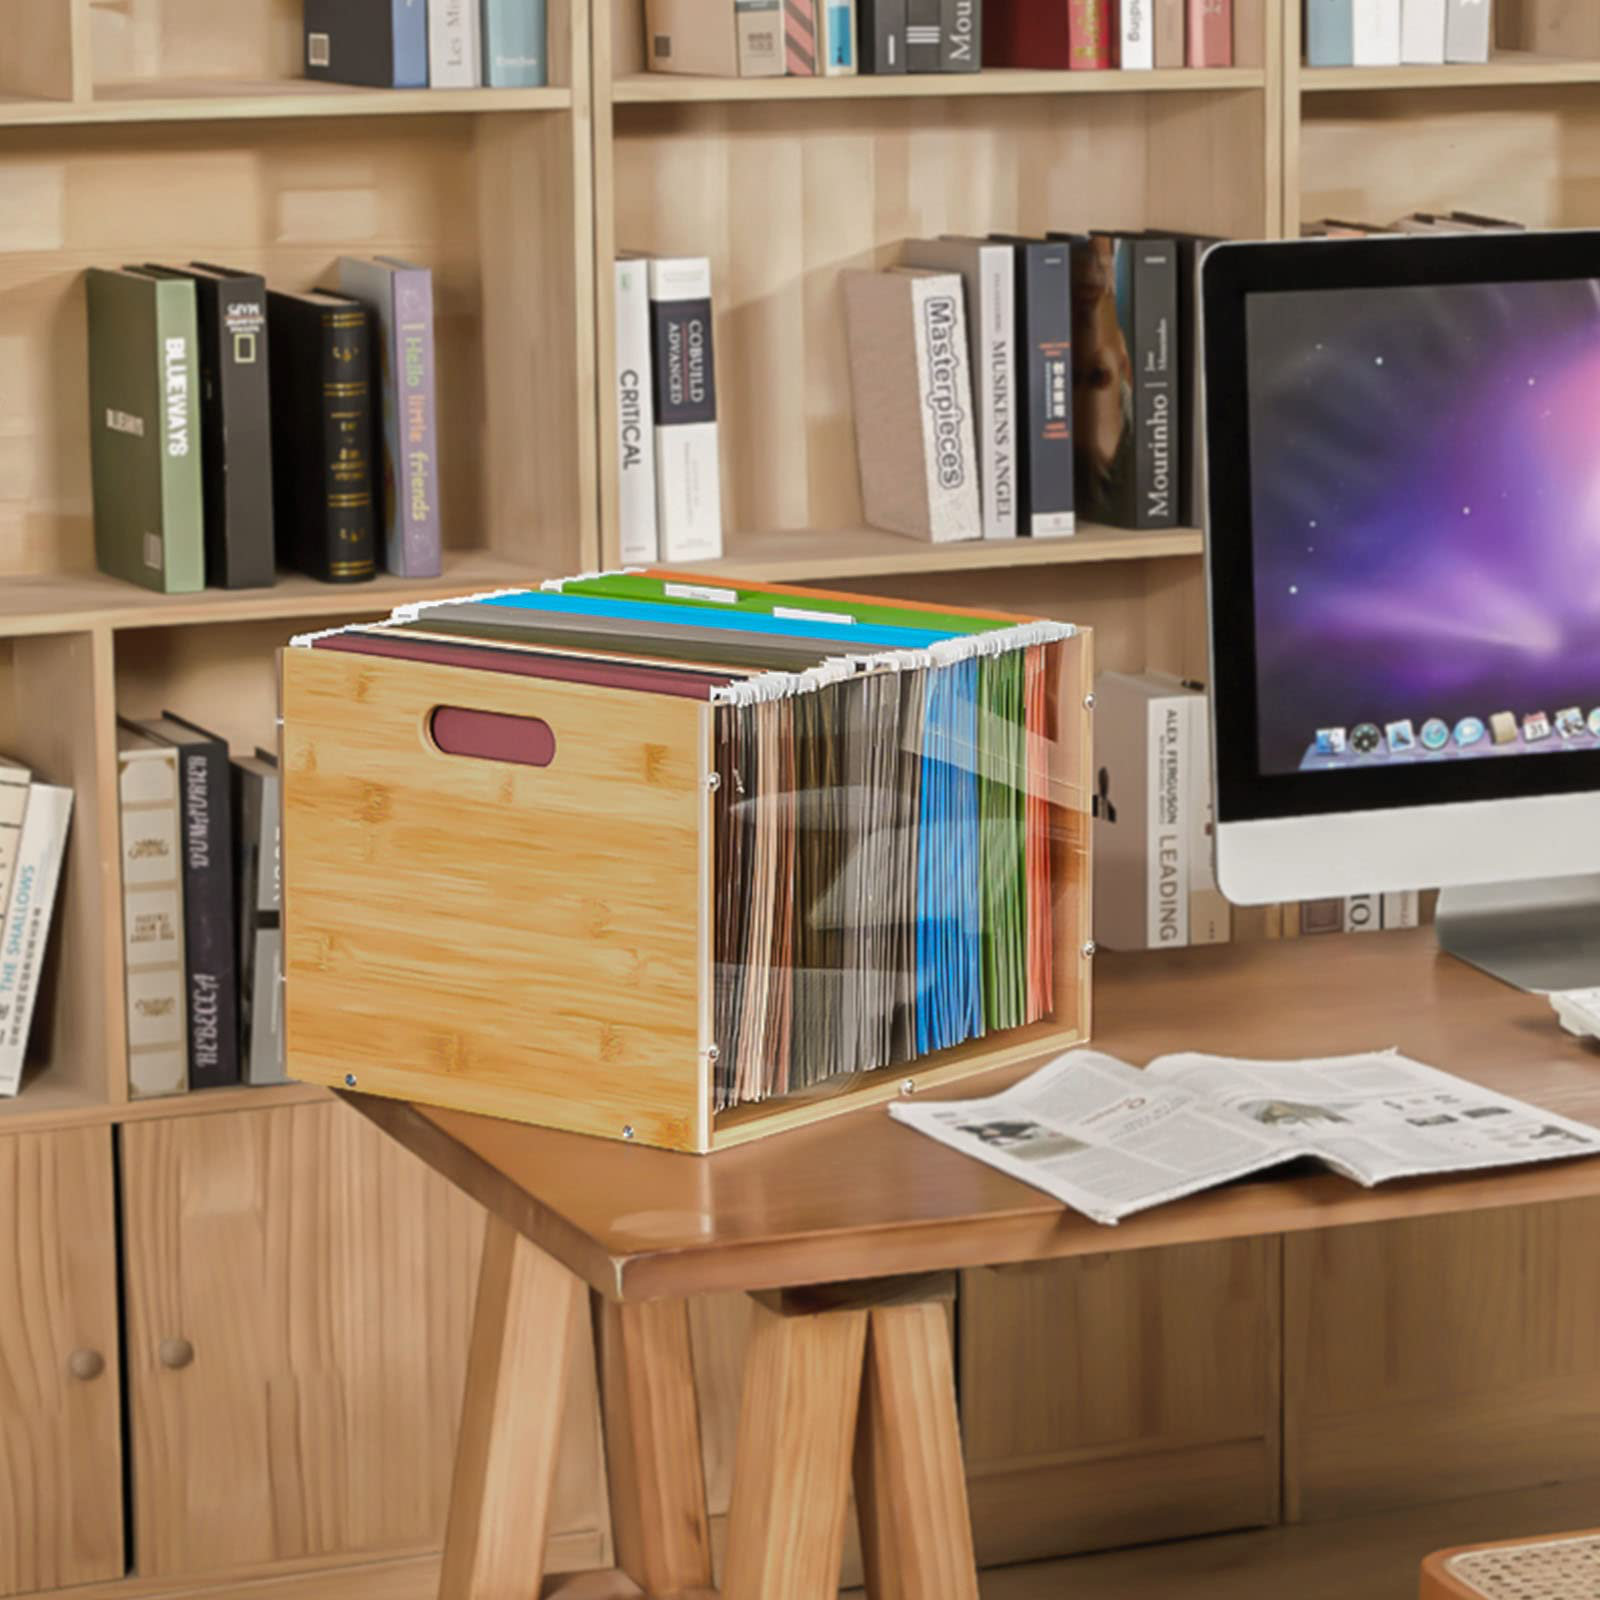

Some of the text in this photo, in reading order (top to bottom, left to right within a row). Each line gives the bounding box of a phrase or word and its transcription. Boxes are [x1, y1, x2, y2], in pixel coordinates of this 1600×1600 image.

[405, 336, 424, 387] Hello
[668, 321, 683, 405] ADVANCED
[688, 319, 704, 403] COBUILD
[929, 300, 962, 486] Masterpieces
[992, 340, 1009, 446] MUSIKENS
[620, 369, 641, 470] CRITICAL
[1145, 394, 1169, 517] Mourinho
[409, 451, 431, 522] friends
[994, 450, 1011, 523] ANGEL
[1165, 708, 1179, 825] ALEX FERGUSON
[6, 863, 34, 956] SHALLOWS
[1158, 834, 1178, 942] LEADING
[193, 973, 219, 1068] REBECCA
